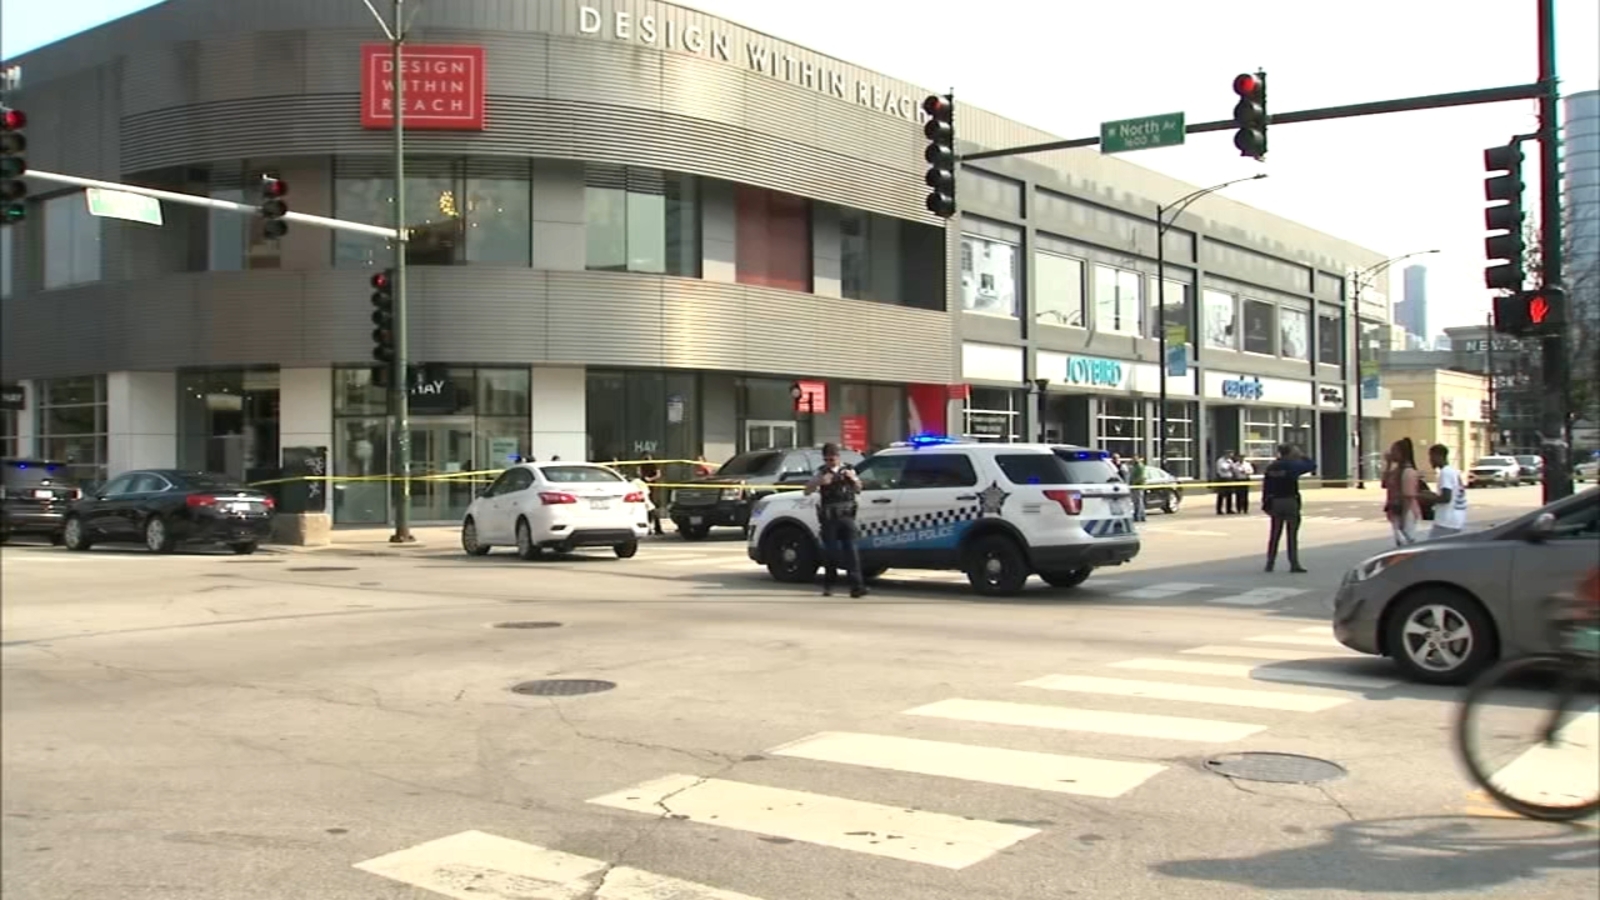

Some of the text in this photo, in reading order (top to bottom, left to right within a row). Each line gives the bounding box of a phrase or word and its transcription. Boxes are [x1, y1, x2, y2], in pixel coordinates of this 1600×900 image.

[382, 60, 465, 73] DESIGN
[579, 6, 930, 124] DESIGN WITHIN REACH
[382, 80, 464, 92] WITHIN
[382, 98, 463, 111] REACH
[1119, 120, 1159, 138] North
[1064, 355, 1122, 387] JOYBIRD
[634, 440, 658, 452] HAY
[918, 525, 955, 542] POLICE
